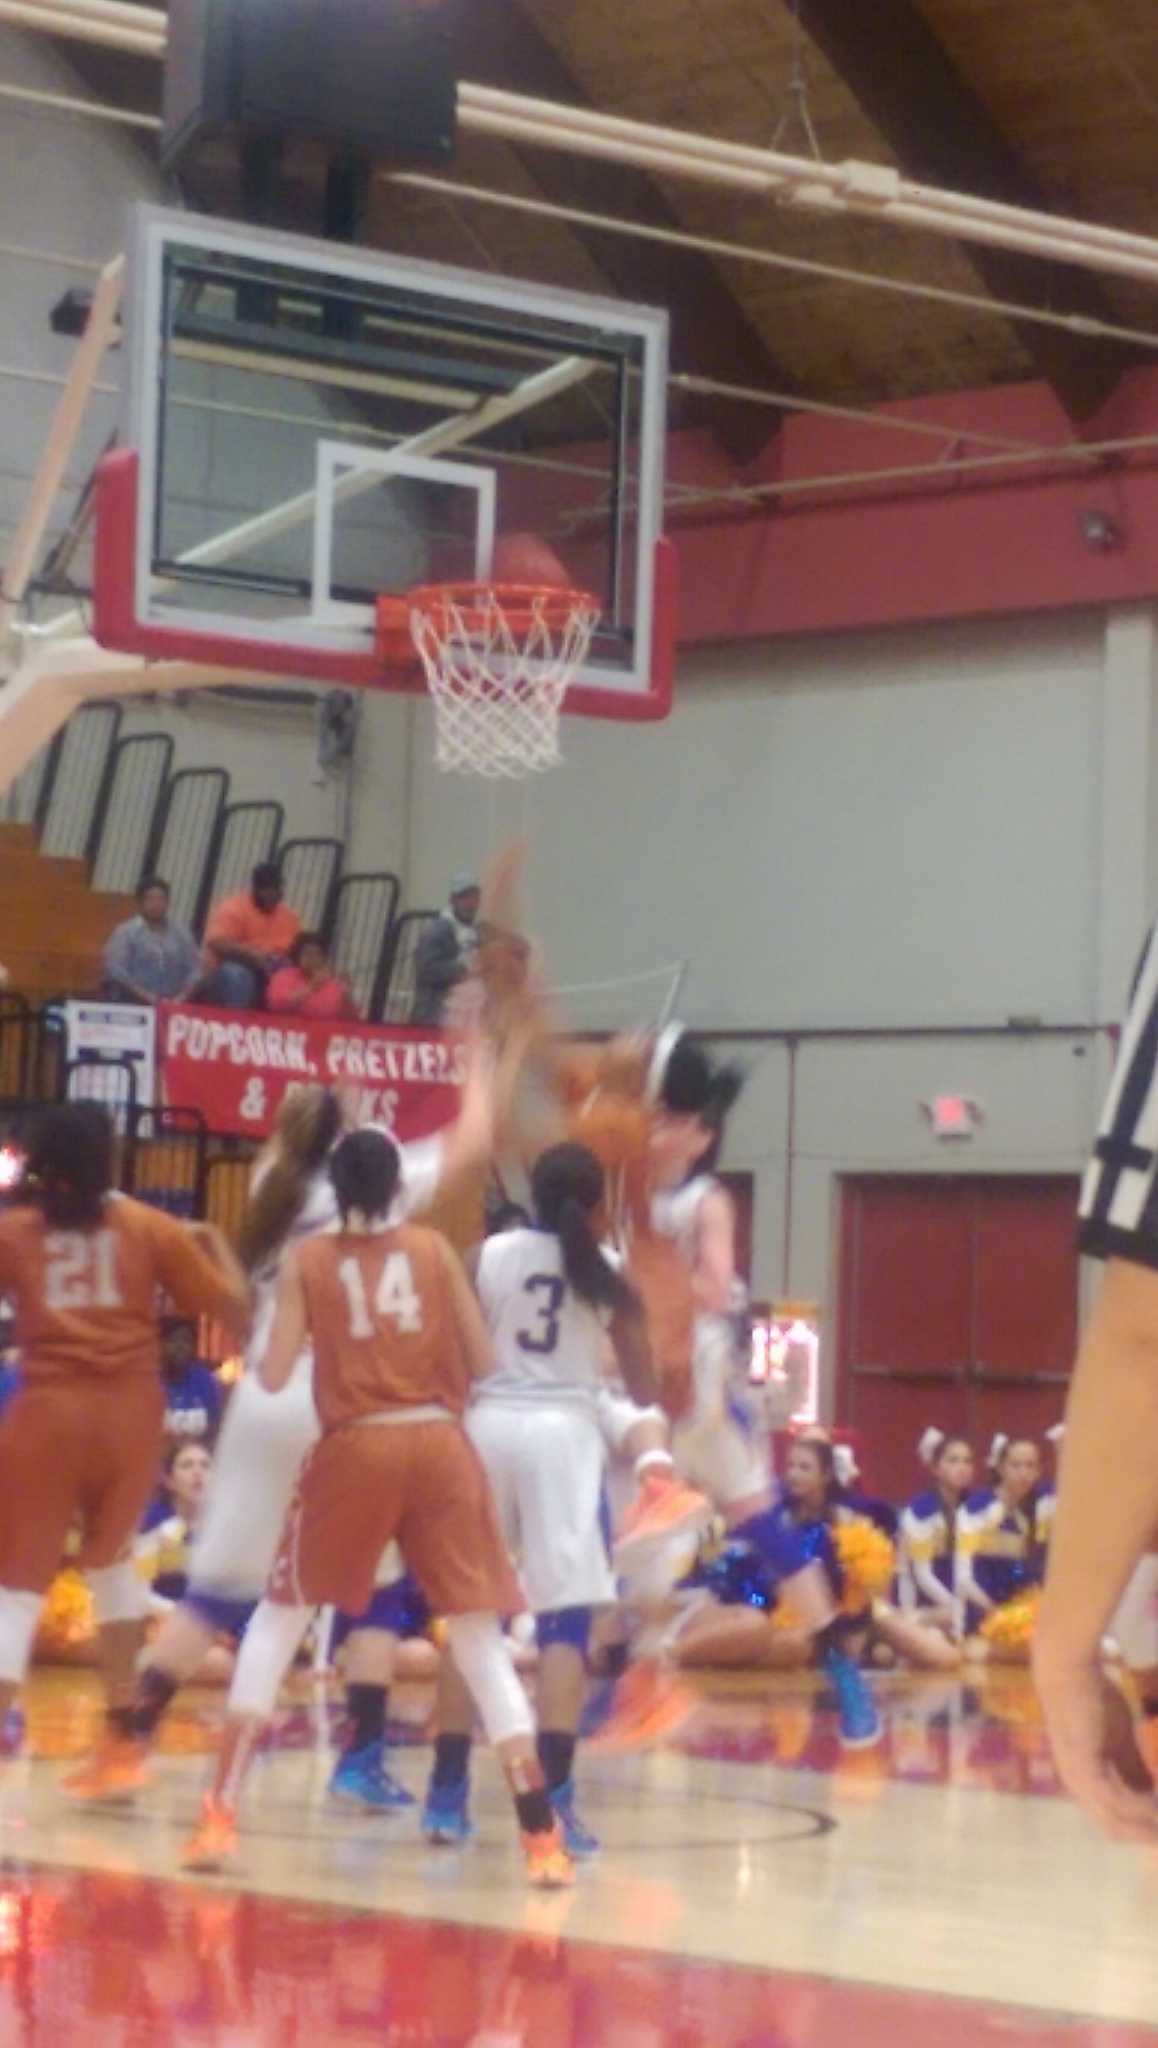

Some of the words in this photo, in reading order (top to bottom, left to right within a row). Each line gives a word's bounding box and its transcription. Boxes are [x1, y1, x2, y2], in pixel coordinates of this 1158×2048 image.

[167, 1014, 318, 1074] POPCORN,
[239, 1077, 265, 1120] &
[44, 1230, 122, 1307] 21
[338, 1252, 422, 1339] 14
[516, 1274, 566, 1353] 3
